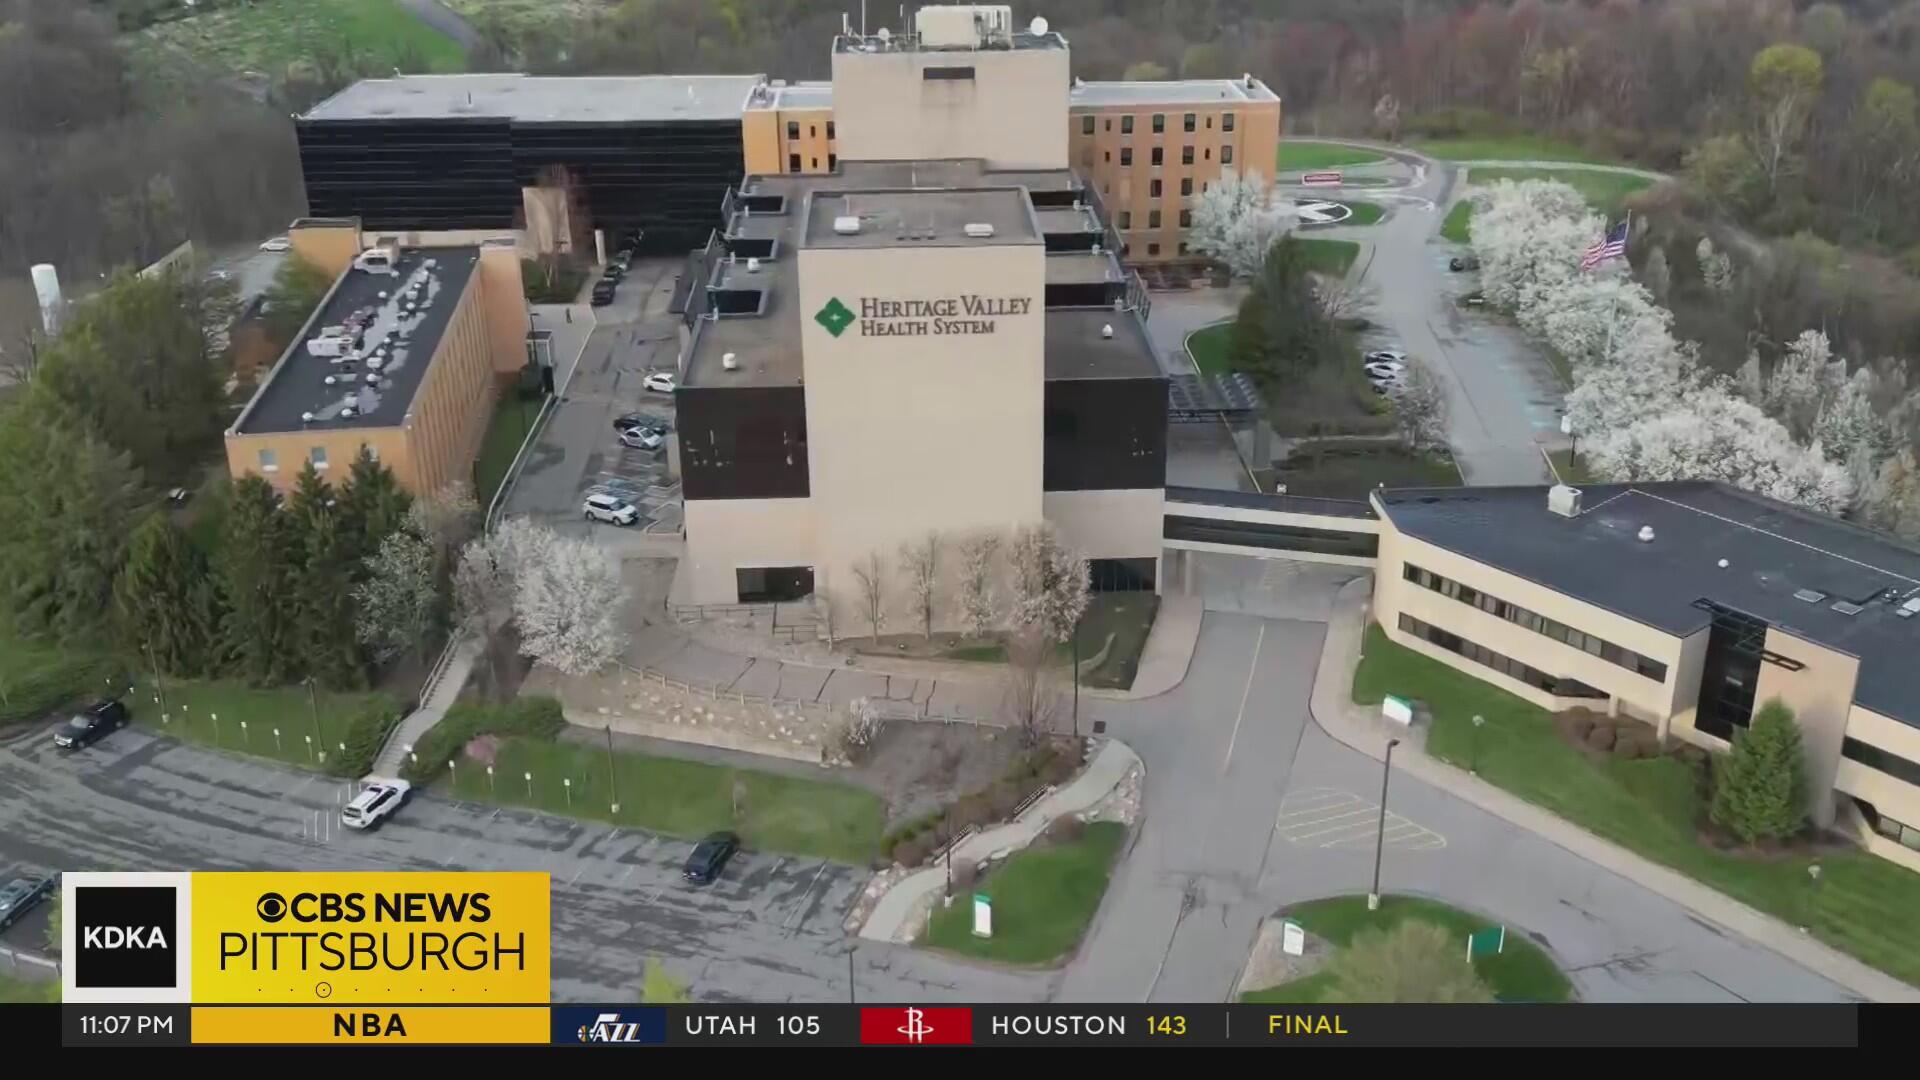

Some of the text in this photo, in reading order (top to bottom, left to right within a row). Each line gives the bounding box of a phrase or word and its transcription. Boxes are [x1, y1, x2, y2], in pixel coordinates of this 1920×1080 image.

[860, 295, 1032, 319] HERITAGE VALLEY
[860, 317, 995, 337] HEALTH SYSTEM
